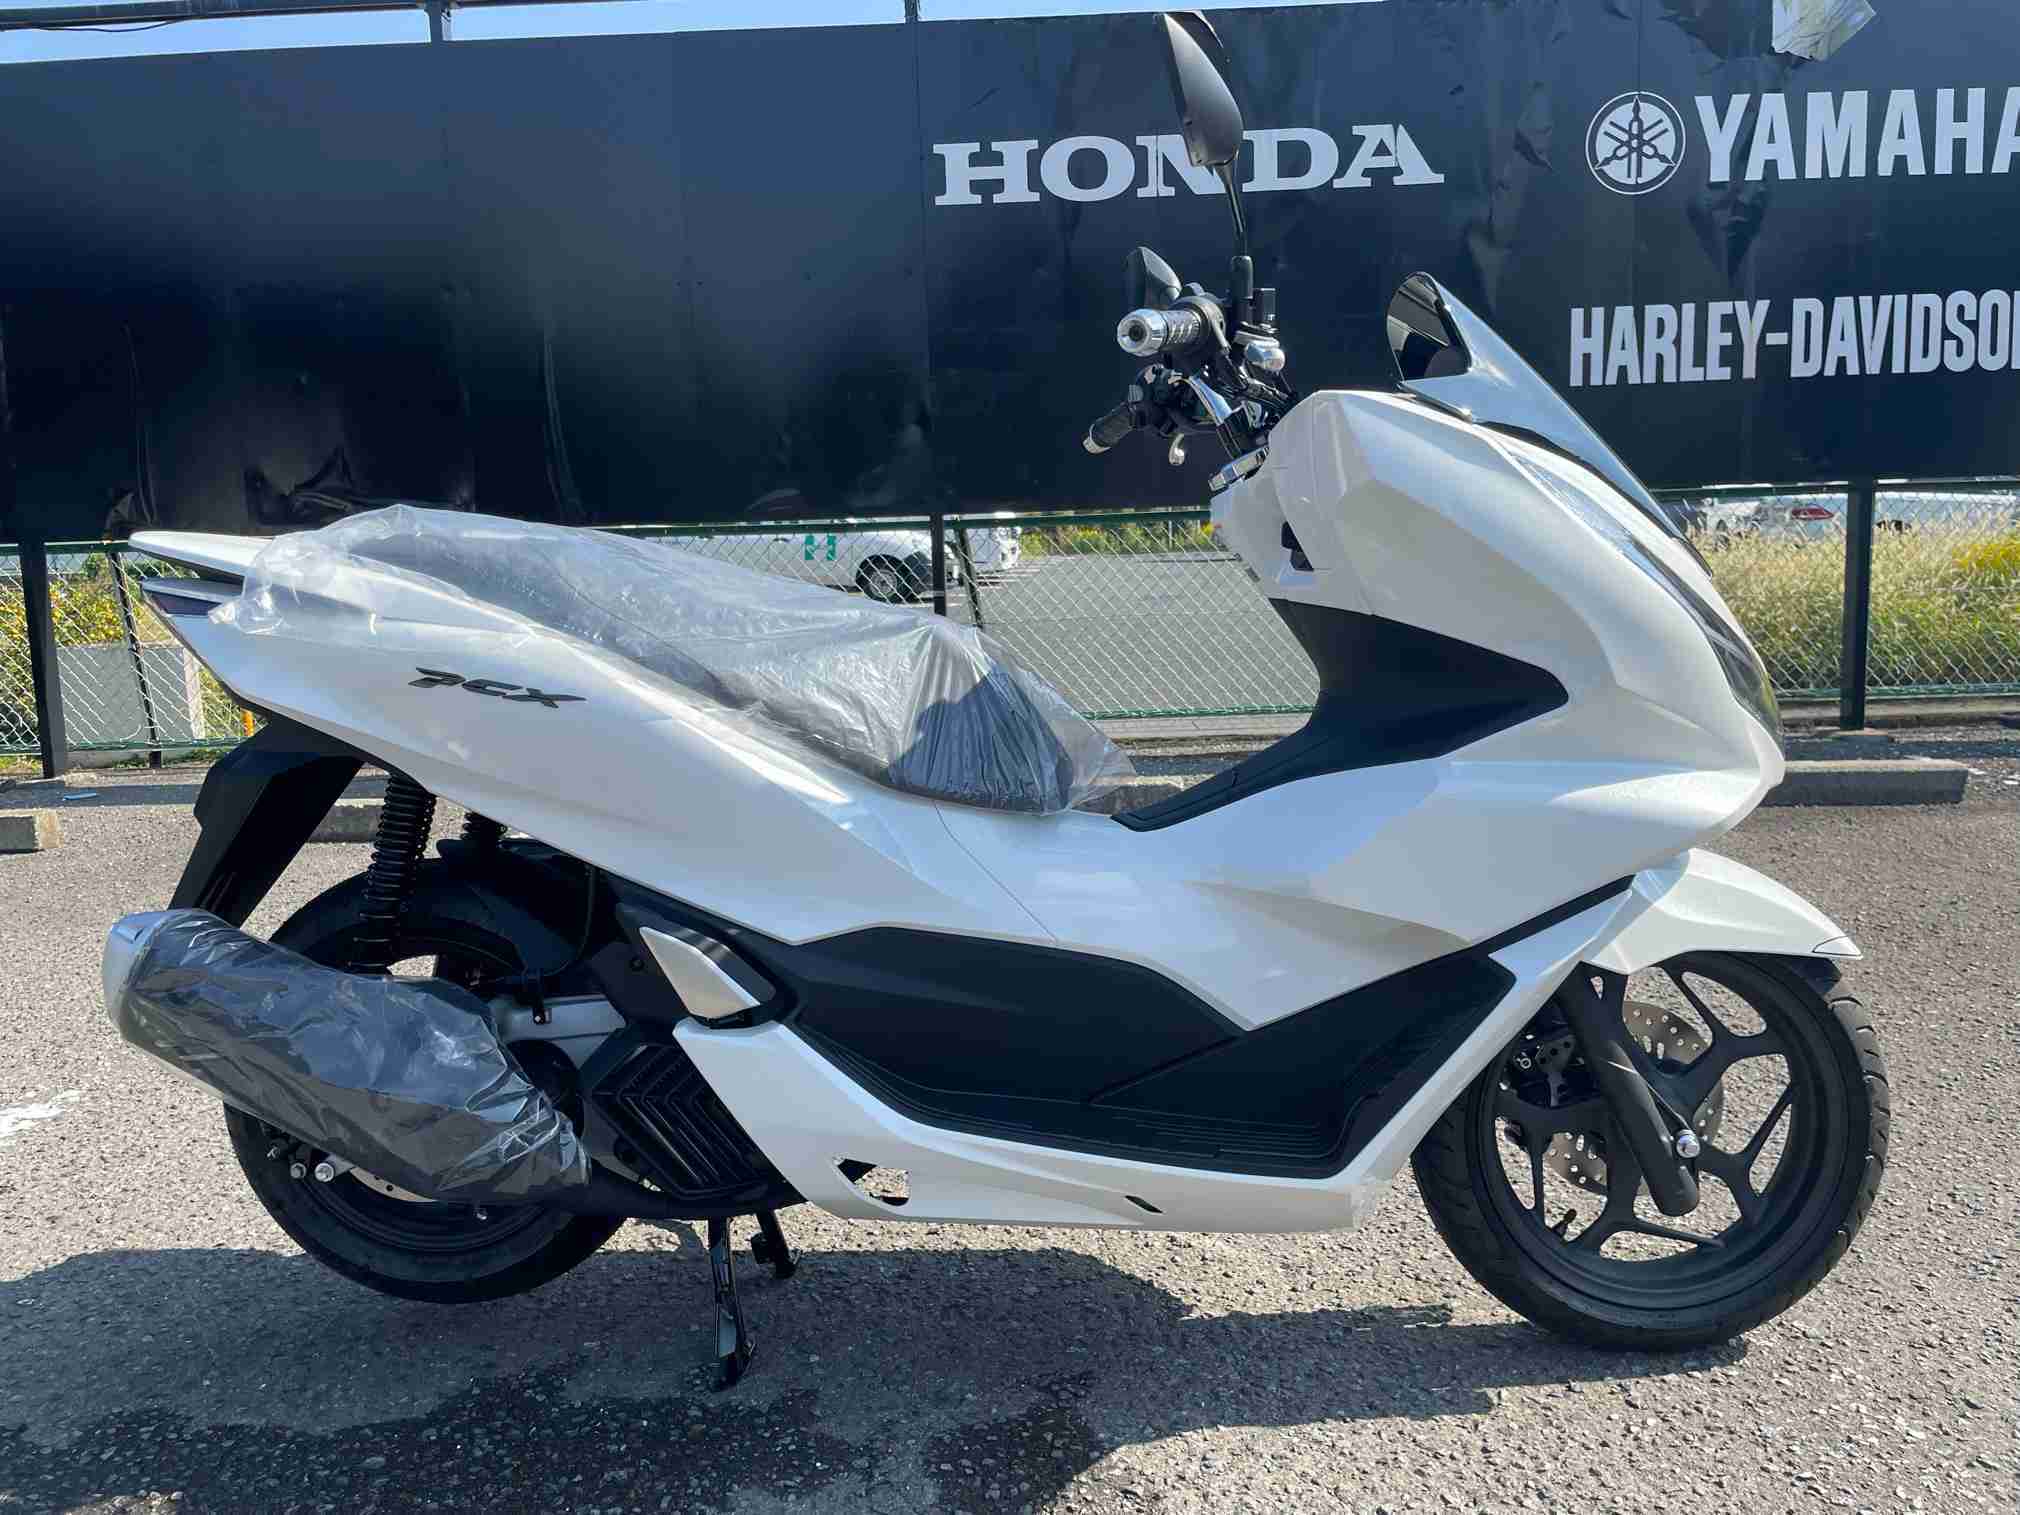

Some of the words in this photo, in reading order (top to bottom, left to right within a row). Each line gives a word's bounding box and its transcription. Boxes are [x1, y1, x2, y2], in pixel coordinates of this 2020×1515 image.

[933, 123, 1444, 206] HONDA
[1569, 289, 2020, 387] HARLEY-DAVIDSO
[408, 666, 587, 708] PCX
